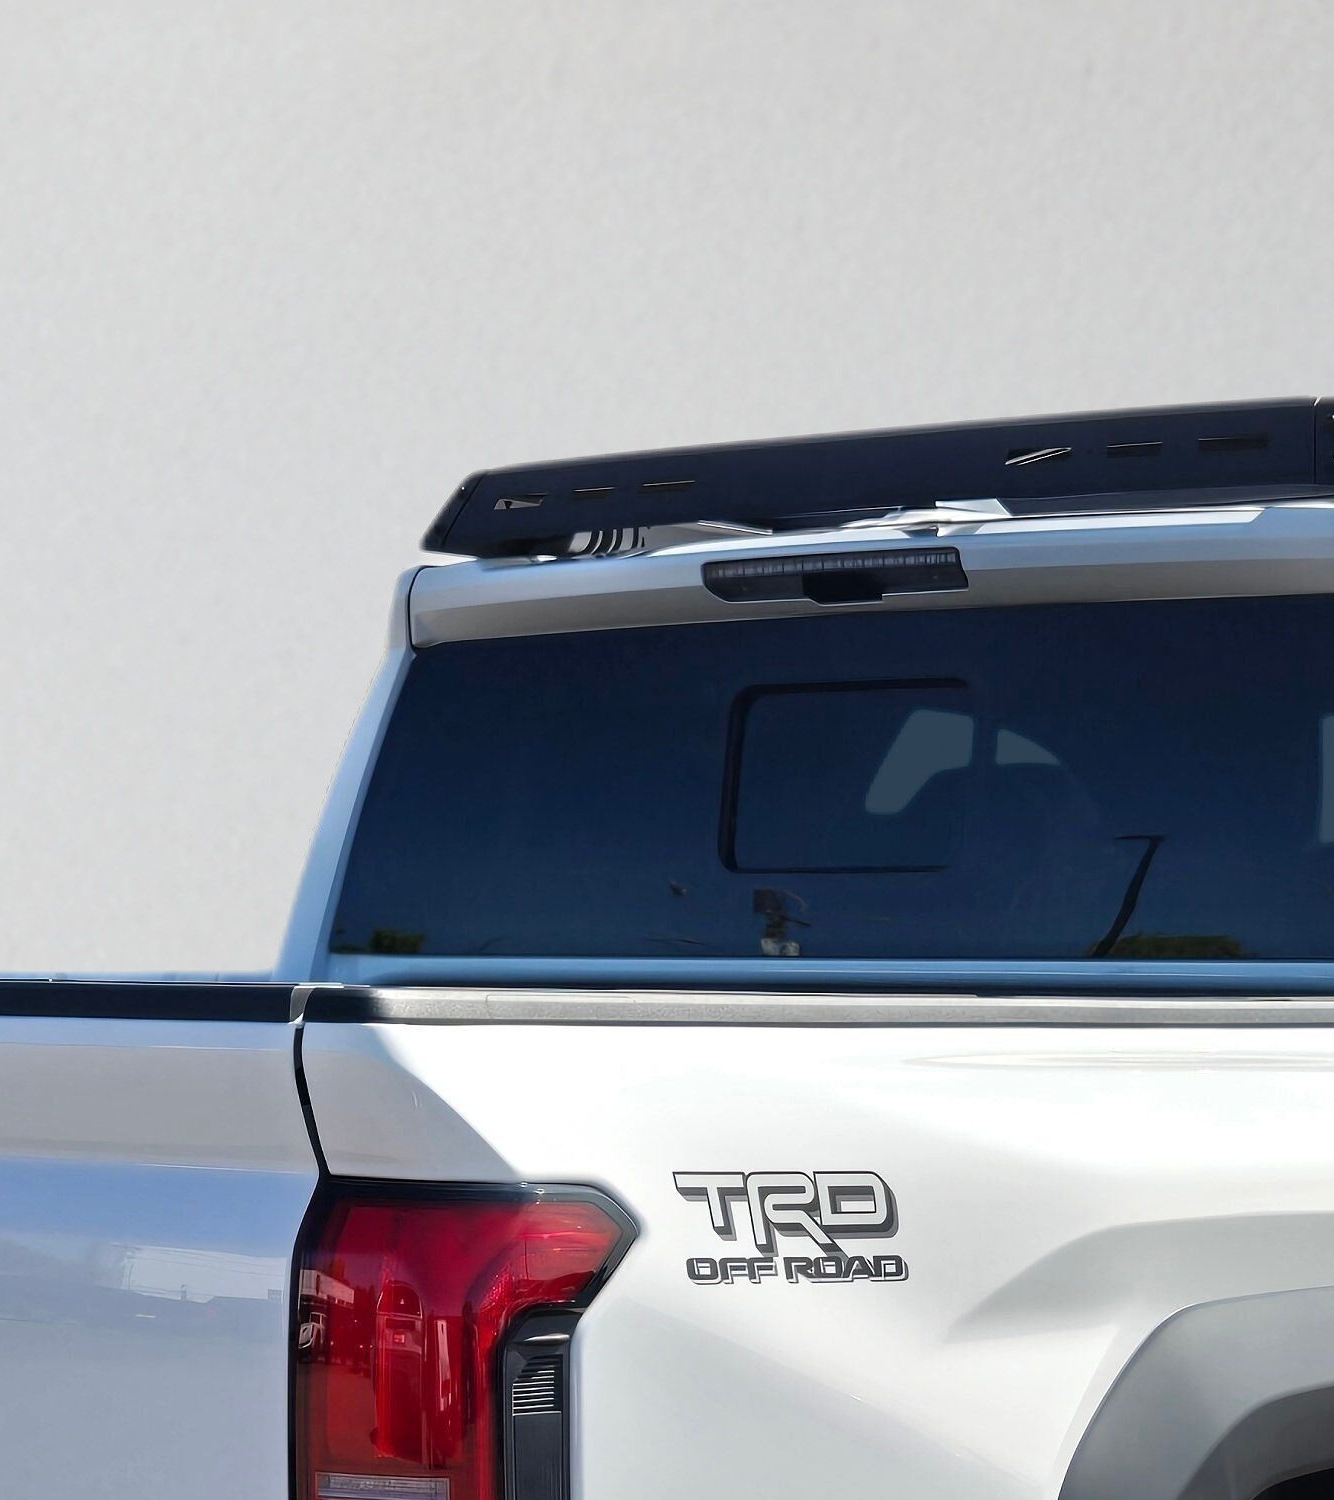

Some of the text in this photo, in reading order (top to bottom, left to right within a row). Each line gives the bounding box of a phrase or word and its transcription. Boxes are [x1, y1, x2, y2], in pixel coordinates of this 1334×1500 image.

[672, 1171, 899, 1261] TRD
[686, 1254, 909, 1285] OFF ROAD
